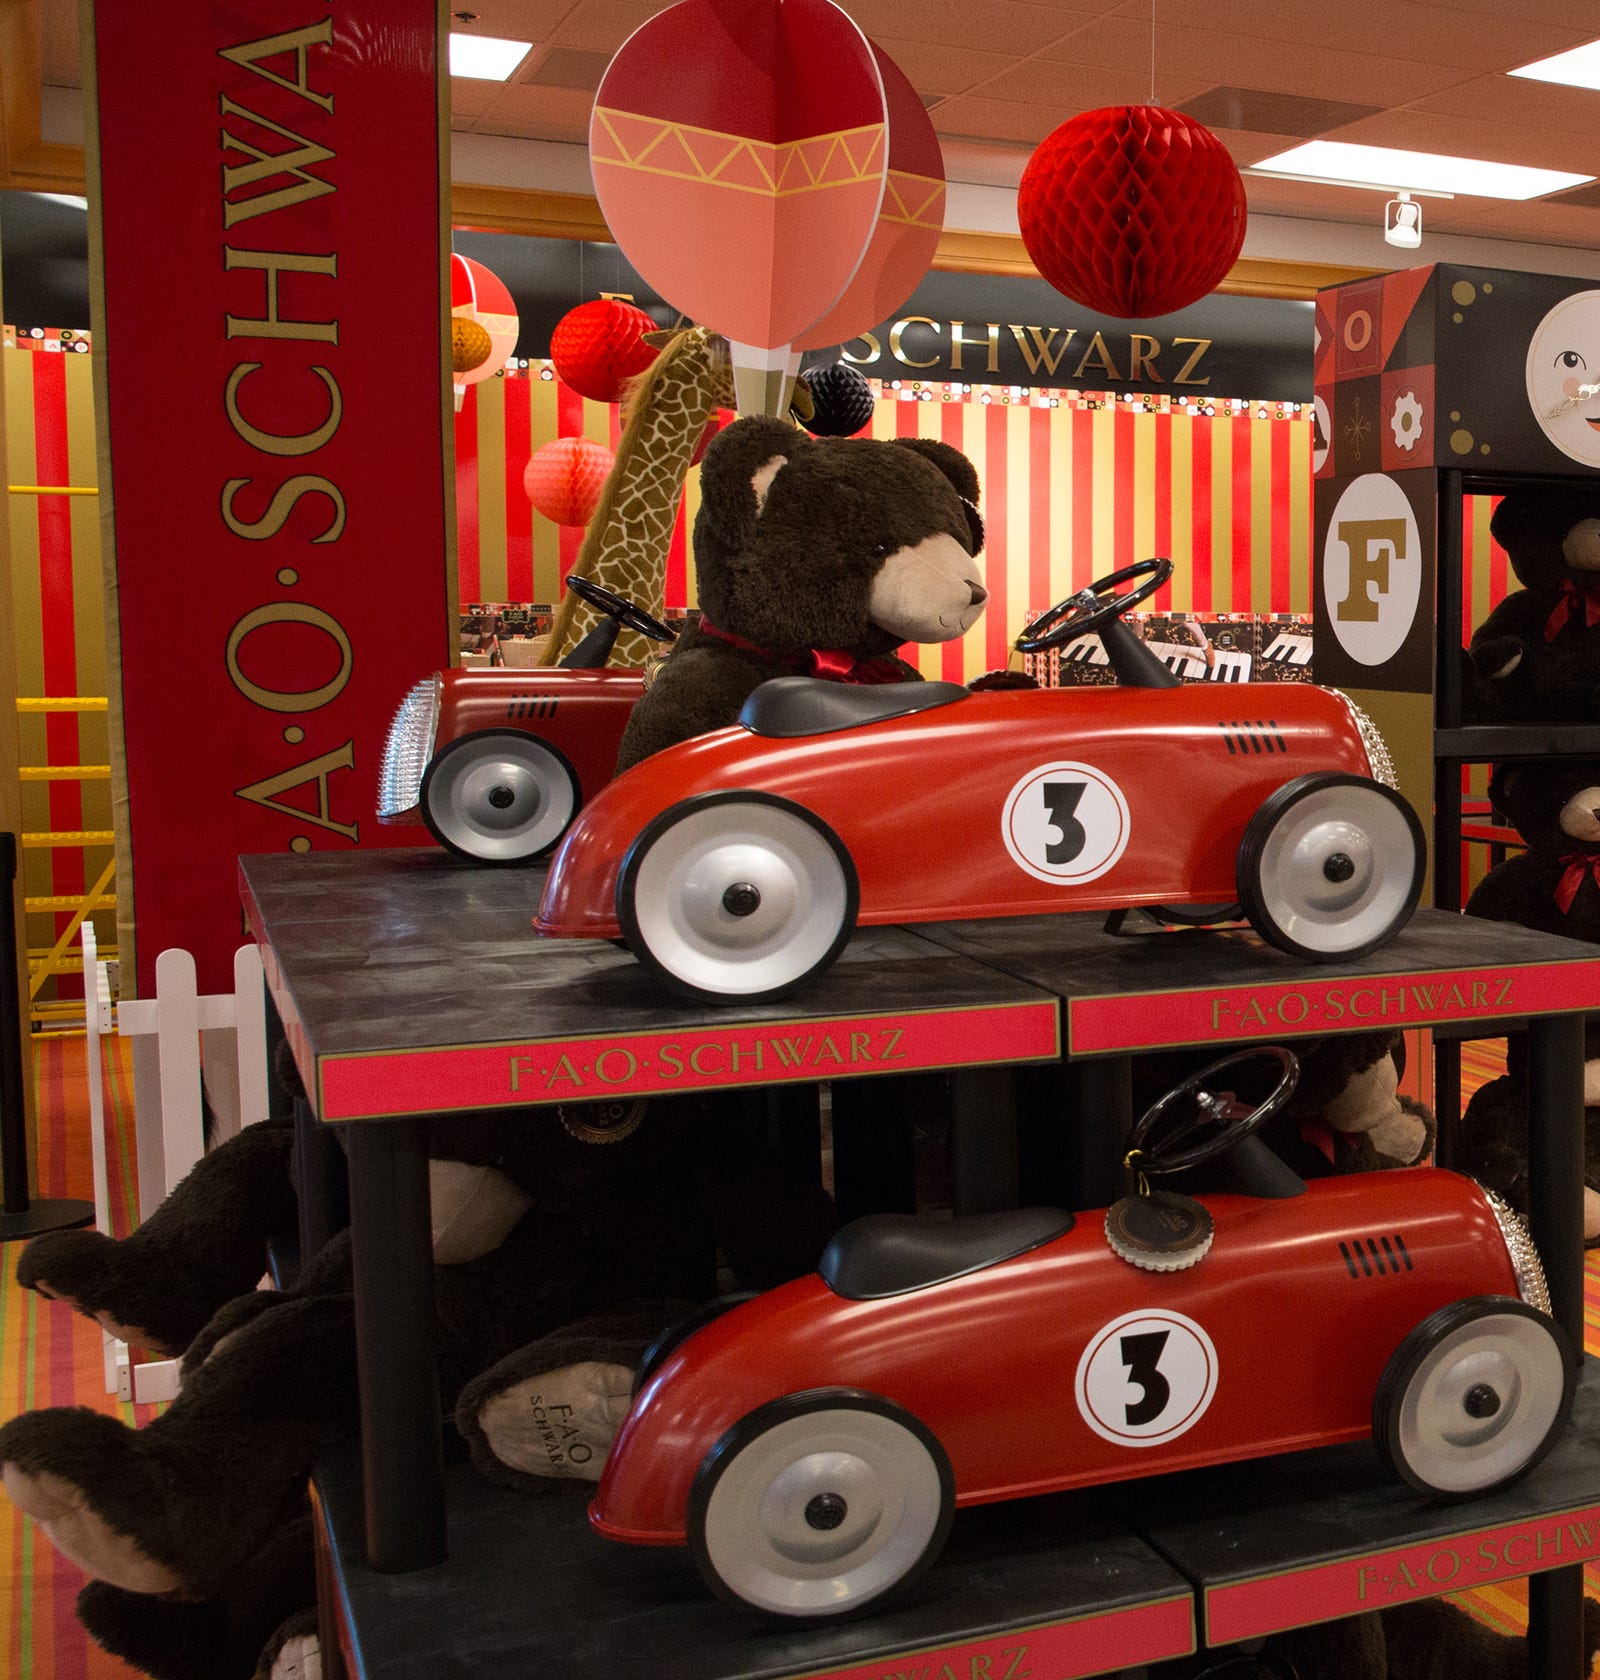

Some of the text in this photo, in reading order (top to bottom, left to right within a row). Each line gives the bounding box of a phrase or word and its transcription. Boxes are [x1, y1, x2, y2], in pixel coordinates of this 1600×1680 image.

[840, 316, 1212, 385] SCHWARZ
[1337, 518, 1407, 622] F
[1043, 782, 1088, 865] 3
[1120, 1330, 1171, 1426] 3
